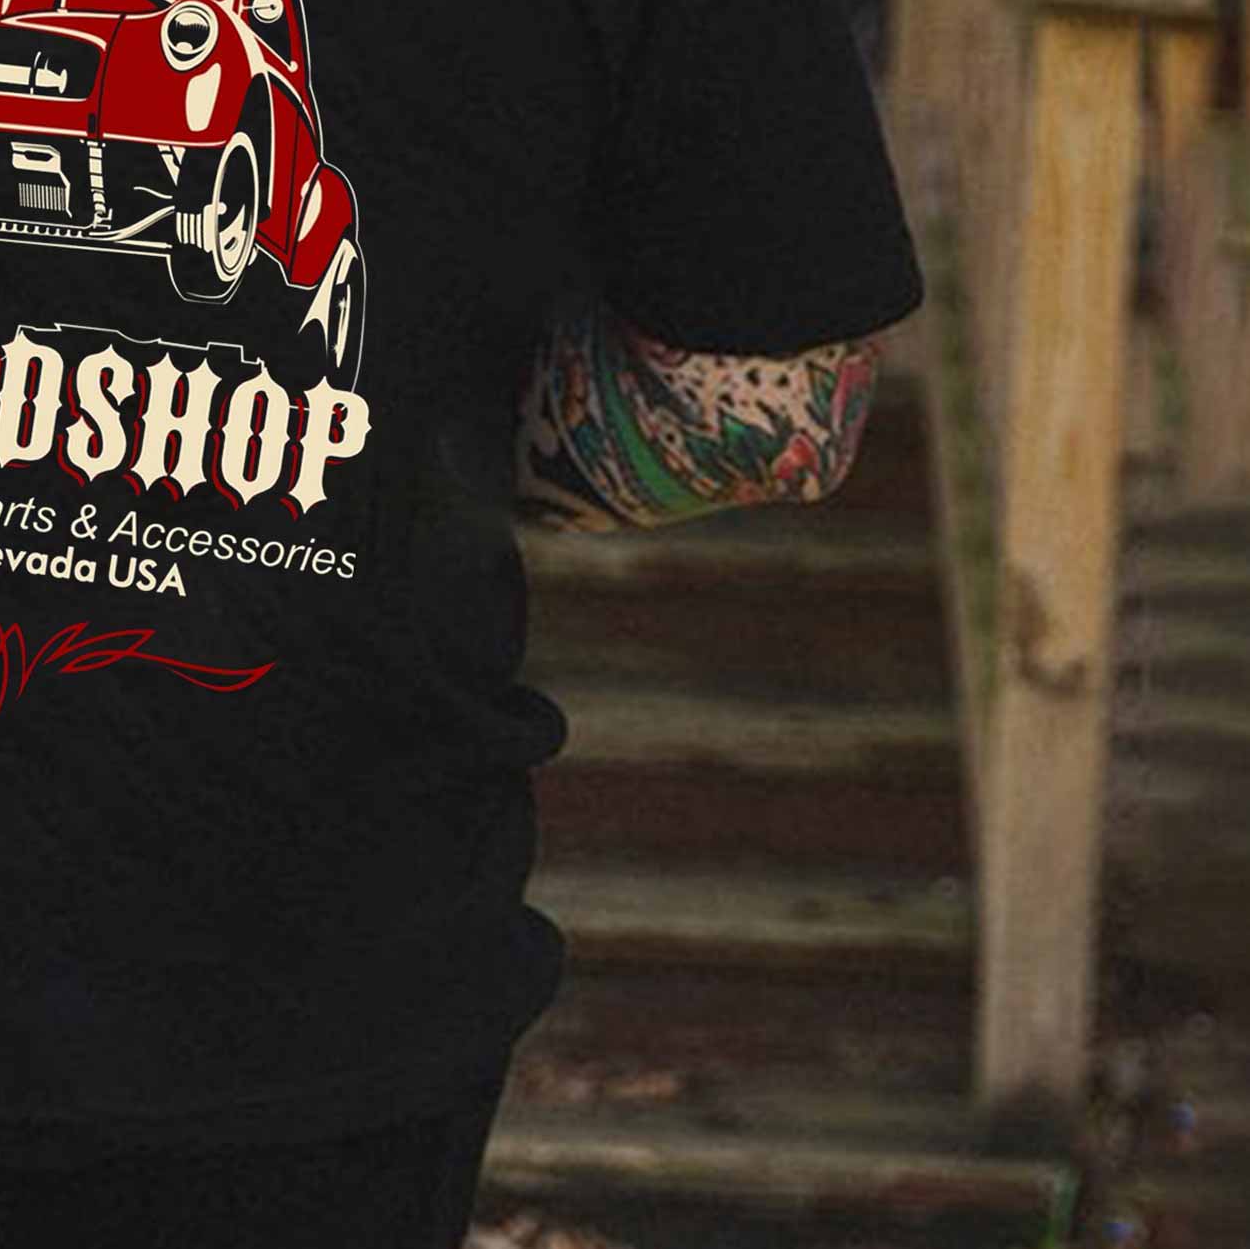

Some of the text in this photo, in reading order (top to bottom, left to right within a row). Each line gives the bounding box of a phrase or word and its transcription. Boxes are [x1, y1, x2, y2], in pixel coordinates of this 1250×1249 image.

[70, 504, 98, 540] &
[108, 511, 357, 579] Accessories
[107, 554, 187, 597] USA
